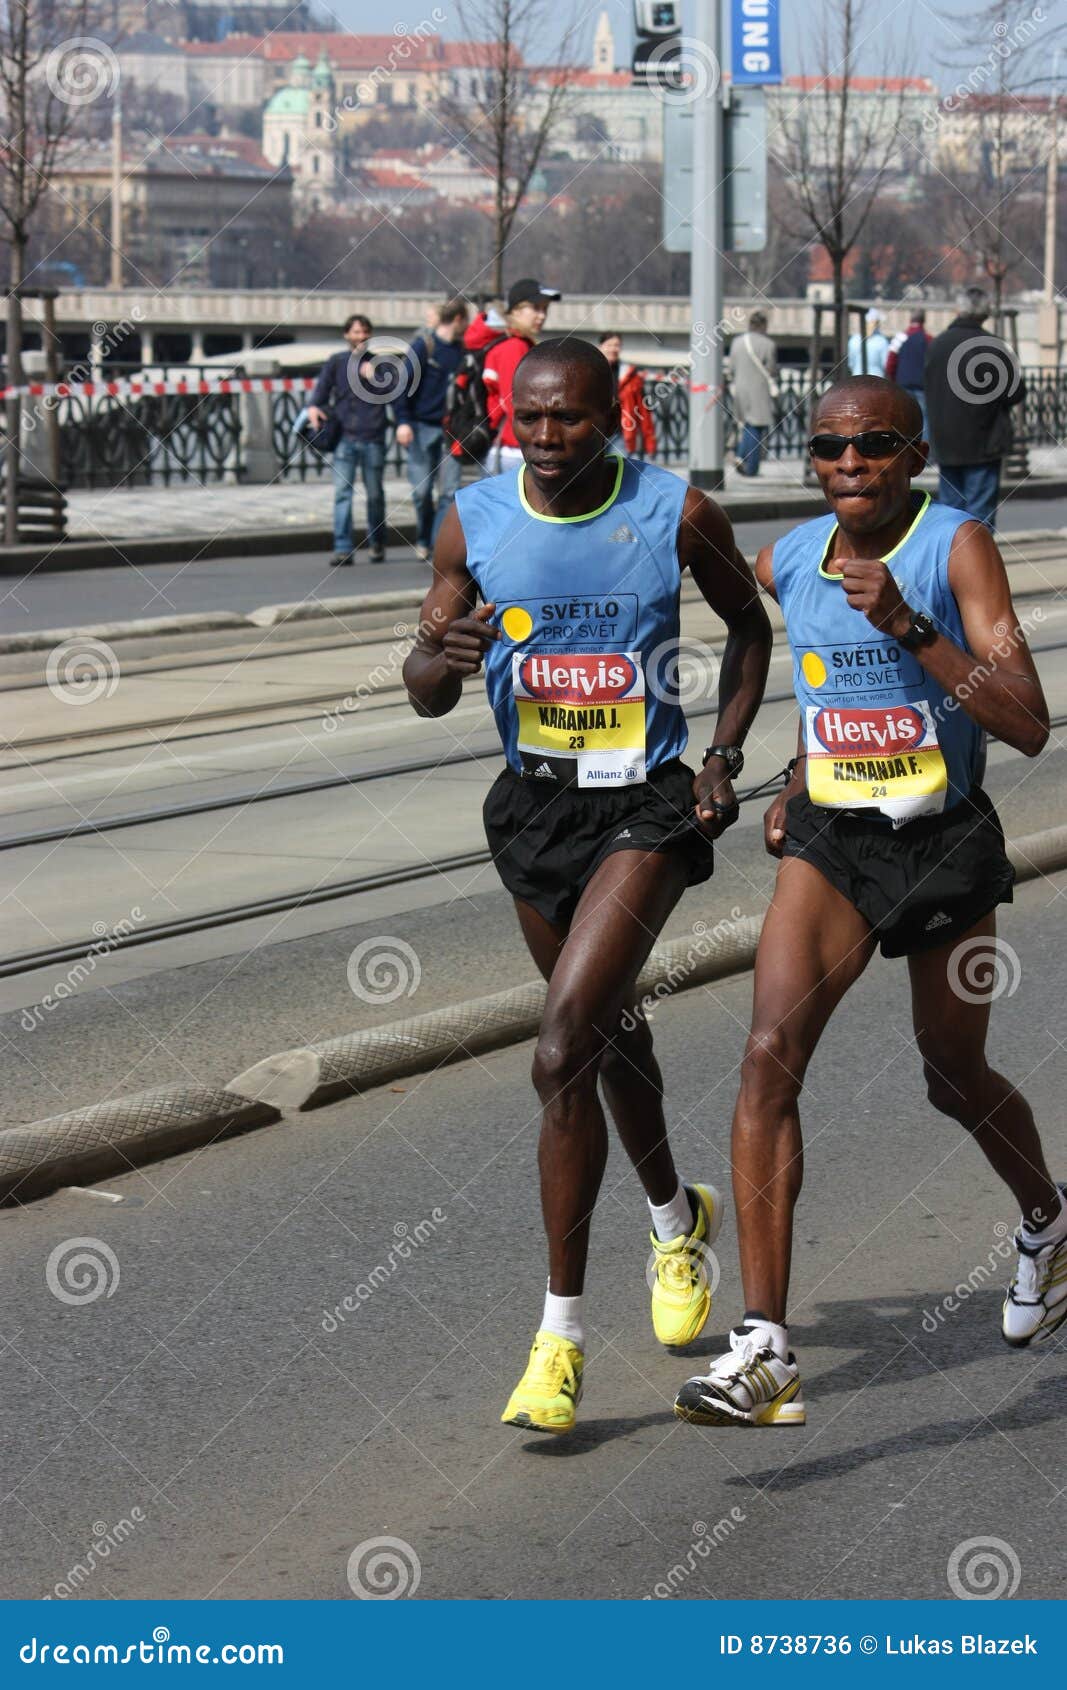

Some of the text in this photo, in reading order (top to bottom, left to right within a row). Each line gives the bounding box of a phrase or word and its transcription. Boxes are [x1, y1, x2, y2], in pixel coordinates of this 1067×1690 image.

[742, 0, 770, 72] UNG
[541, 598, 619, 621] SVĚTLO
[543, 621, 617, 640] PRO SVĚT
[832, 644, 901, 669] SVĚTLO
[531, 657, 626, 696] Hervis
[834, 667, 903, 688] PRO SVĚT
[538, 706, 622, 731] KARANJA J.
[823, 711, 917, 748] Hervis
[568, 736, 585, 749] 23
[586, 770, 622, 780] Allianz
[833, 756, 923, 782] KARANJA F.
[871, 785, 888, 798] 24
